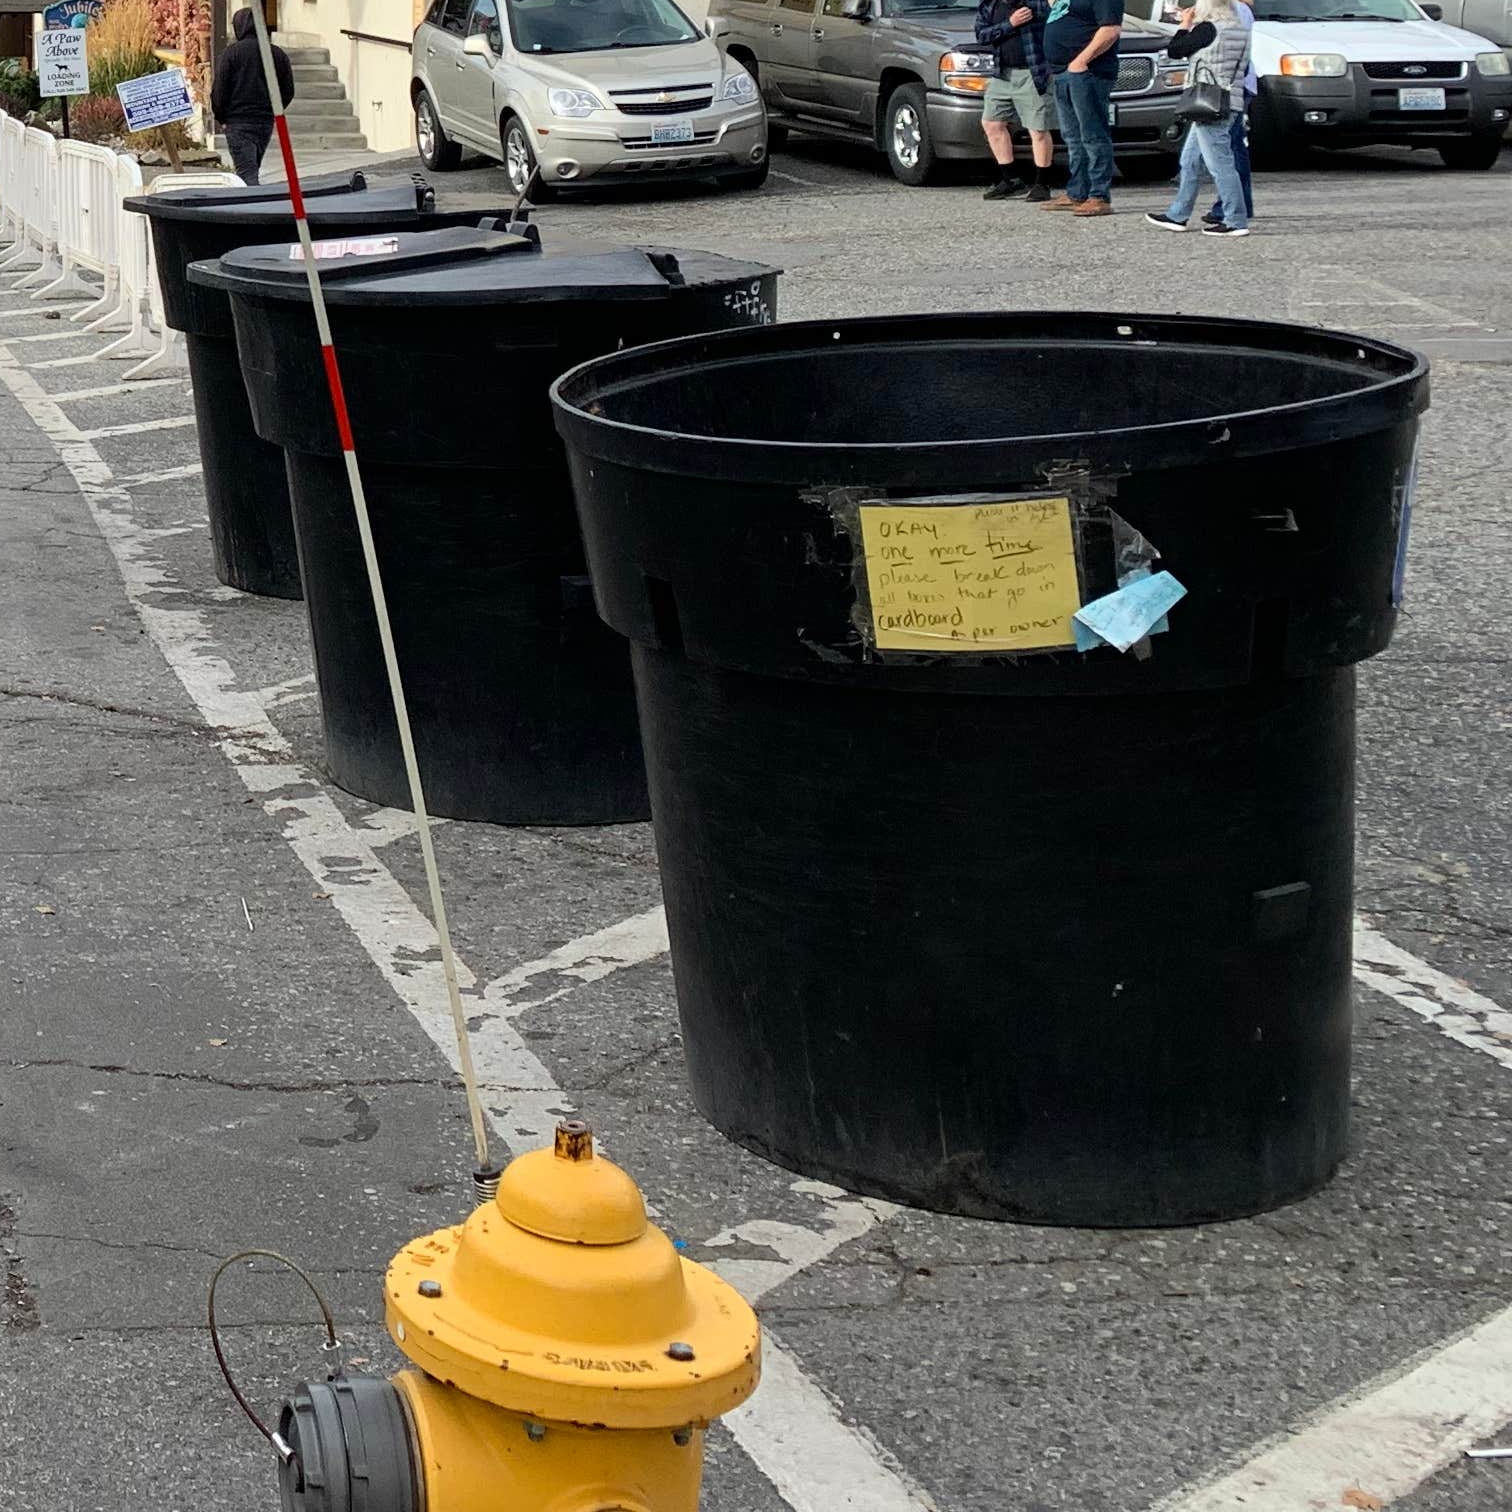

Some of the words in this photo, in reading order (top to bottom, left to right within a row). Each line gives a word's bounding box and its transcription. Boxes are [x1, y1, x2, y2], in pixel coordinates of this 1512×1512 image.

[60, 0, 104, 19] Jubile
[41, 33, 52, 45] A
[55, 33, 82, 44] Paw
[45, 45, 79, 57] Above
[47, 72, 81, 81] LOADING
[55, 80, 74, 88] ZONE
[881, 546, 914, 560] one
[929, 544, 976, 558] more
[985, 529, 1042, 555] time
[879, 568, 936, 589] please
[954, 566, 1009, 583] break
[958, 587, 998, 599] that
[1008, 588, 1026, 608] go
[1039, 576, 1056, 592] in
[878, 606, 964, 631] cardboard
[1010, 616, 1064, 634] owner
